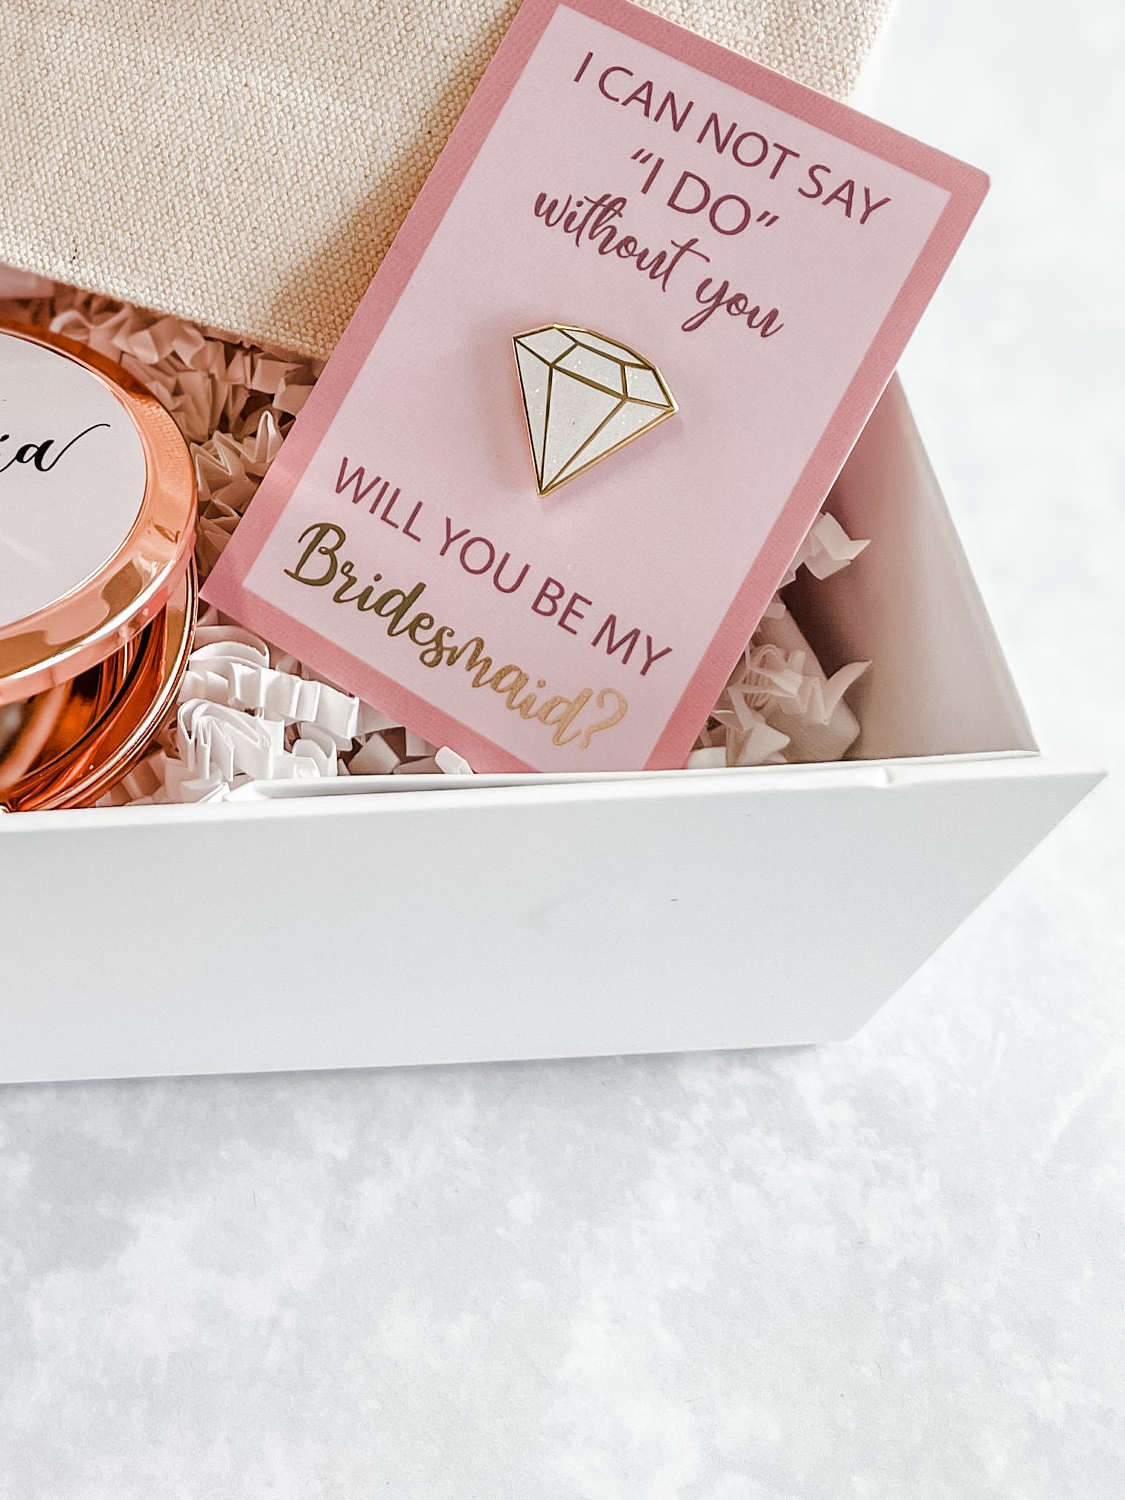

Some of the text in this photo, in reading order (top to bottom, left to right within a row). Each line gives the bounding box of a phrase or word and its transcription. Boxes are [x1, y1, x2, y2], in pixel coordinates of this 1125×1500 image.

[574, 52, 891, 225] I CAN NOT SAY
[534, 191, 785, 338] without you
[284, 522, 628, 749] Bridesmaid?
[335, 456, 673, 676] WILL YOU BE MY
